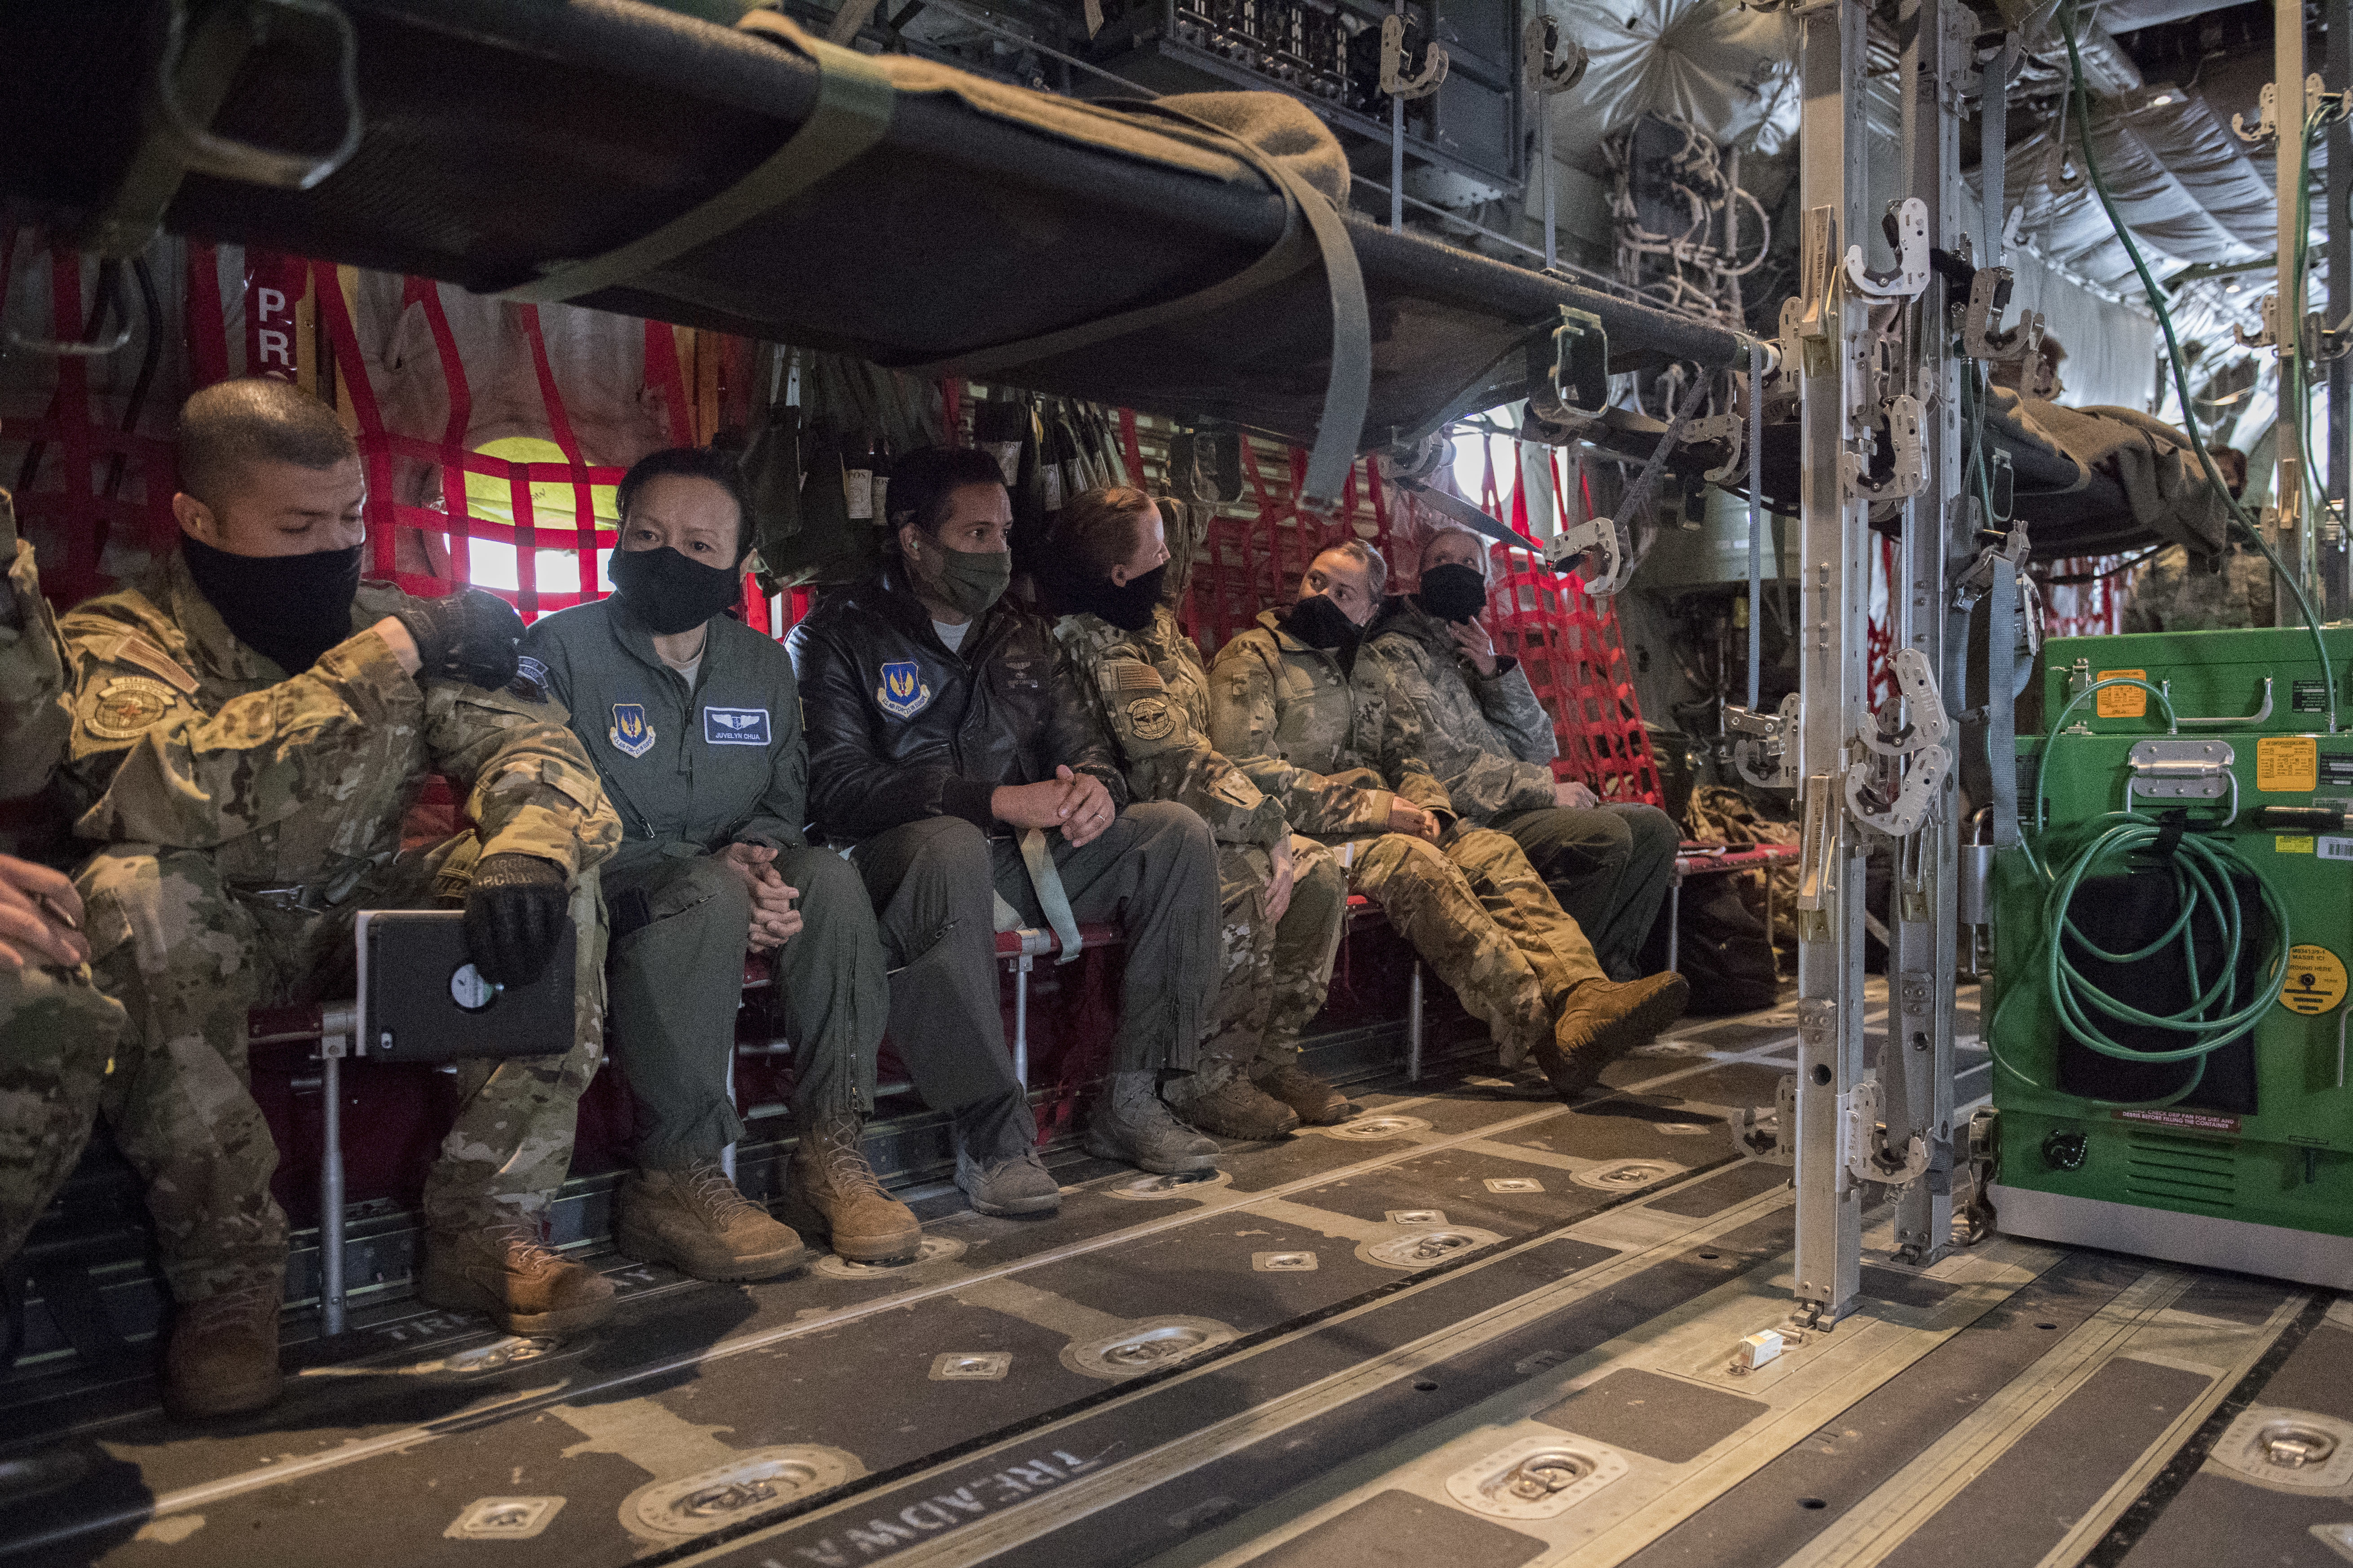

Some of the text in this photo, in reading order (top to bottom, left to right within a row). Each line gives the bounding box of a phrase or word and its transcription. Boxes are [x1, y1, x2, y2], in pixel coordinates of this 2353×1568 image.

[258, 287, 290, 375] PR
[896, 705, 911, 714] FORCES
[914, 694, 927, 708] EUROPE
[626, 745, 640, 755] FORCES
[2195, 1120, 2229, 1128] CONTAINER
[760, 1449, 1101, 1568] TREADWA
